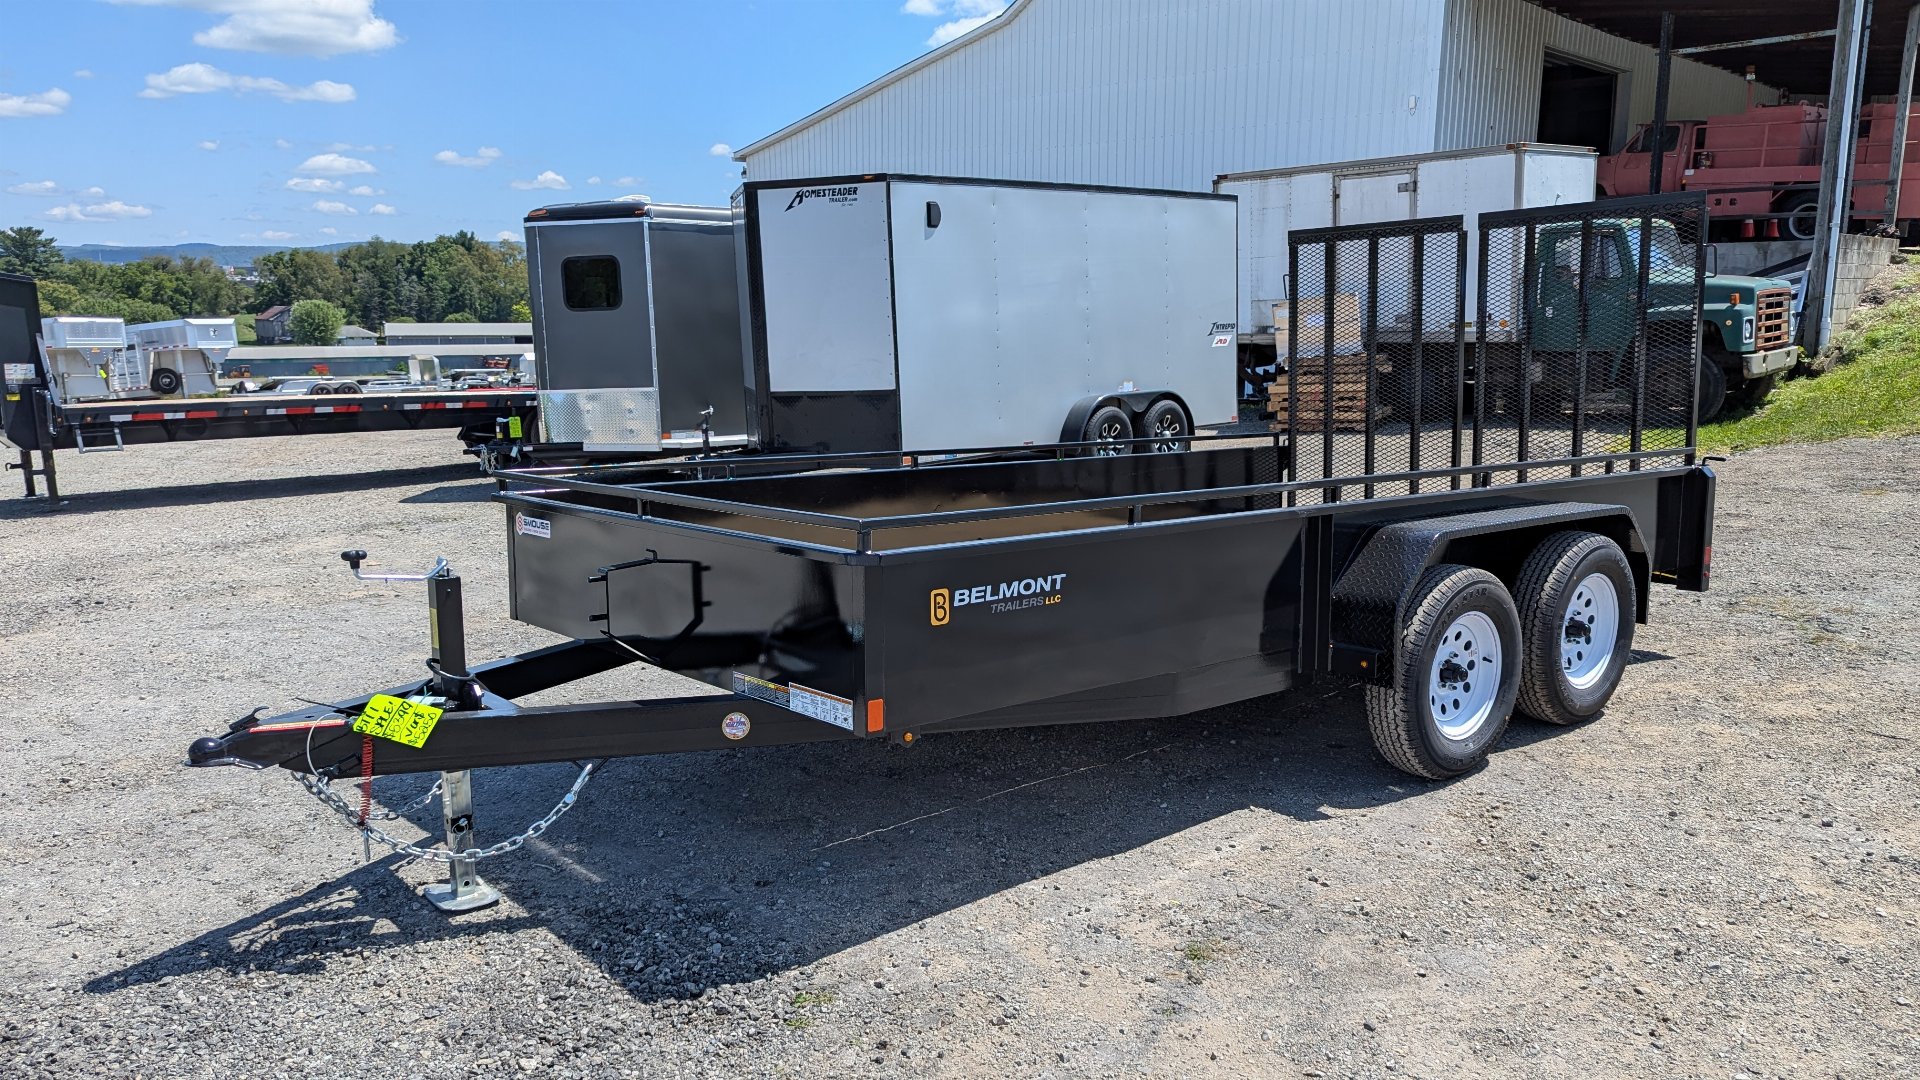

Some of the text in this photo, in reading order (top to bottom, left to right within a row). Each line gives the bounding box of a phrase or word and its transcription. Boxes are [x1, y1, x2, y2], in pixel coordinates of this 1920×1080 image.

[784, 187, 858, 212] HOMESTEADER
[523, 518, 549, 530] SMOUSE
[953, 573, 1067, 607] BELMONT
[990, 594, 1062, 613] TRAILERS LLC
